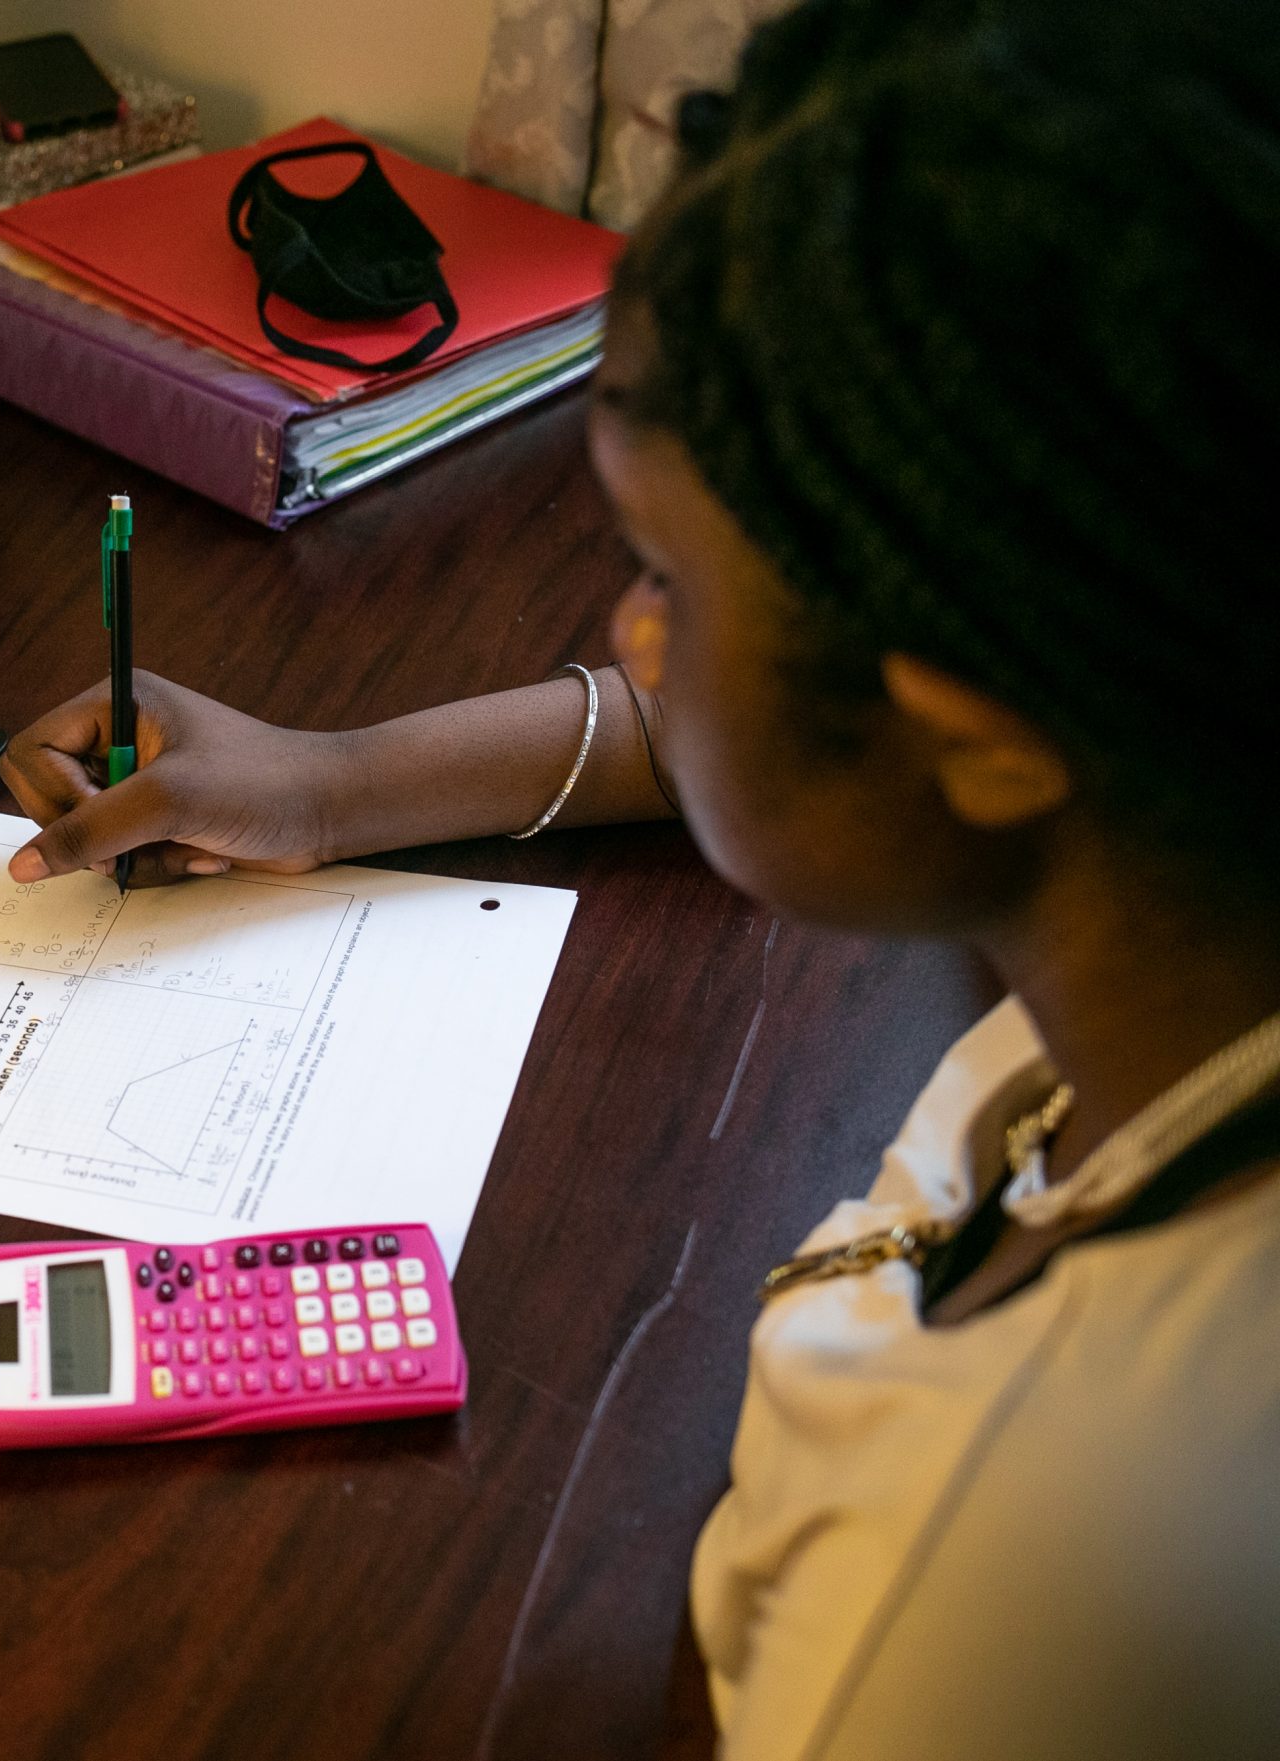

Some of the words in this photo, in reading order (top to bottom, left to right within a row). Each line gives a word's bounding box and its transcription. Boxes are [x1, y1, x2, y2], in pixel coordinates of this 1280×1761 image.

[95, 898, 118, 919] m/s
[322, 993, 333, 1010] about
[328, 982, 338, 993] that
[334, 965, 345, 982] graph
[340, 953, 350, 965] that
[346, 931, 360, 953] explains
[359, 906, 370, 922] object
[22, 991, 34, 1000] 45
[15, 1005, 26, 1015] 40
[6, 1019, 18, 1028] 35
[6, 1018, 43, 1065] (seconds)
